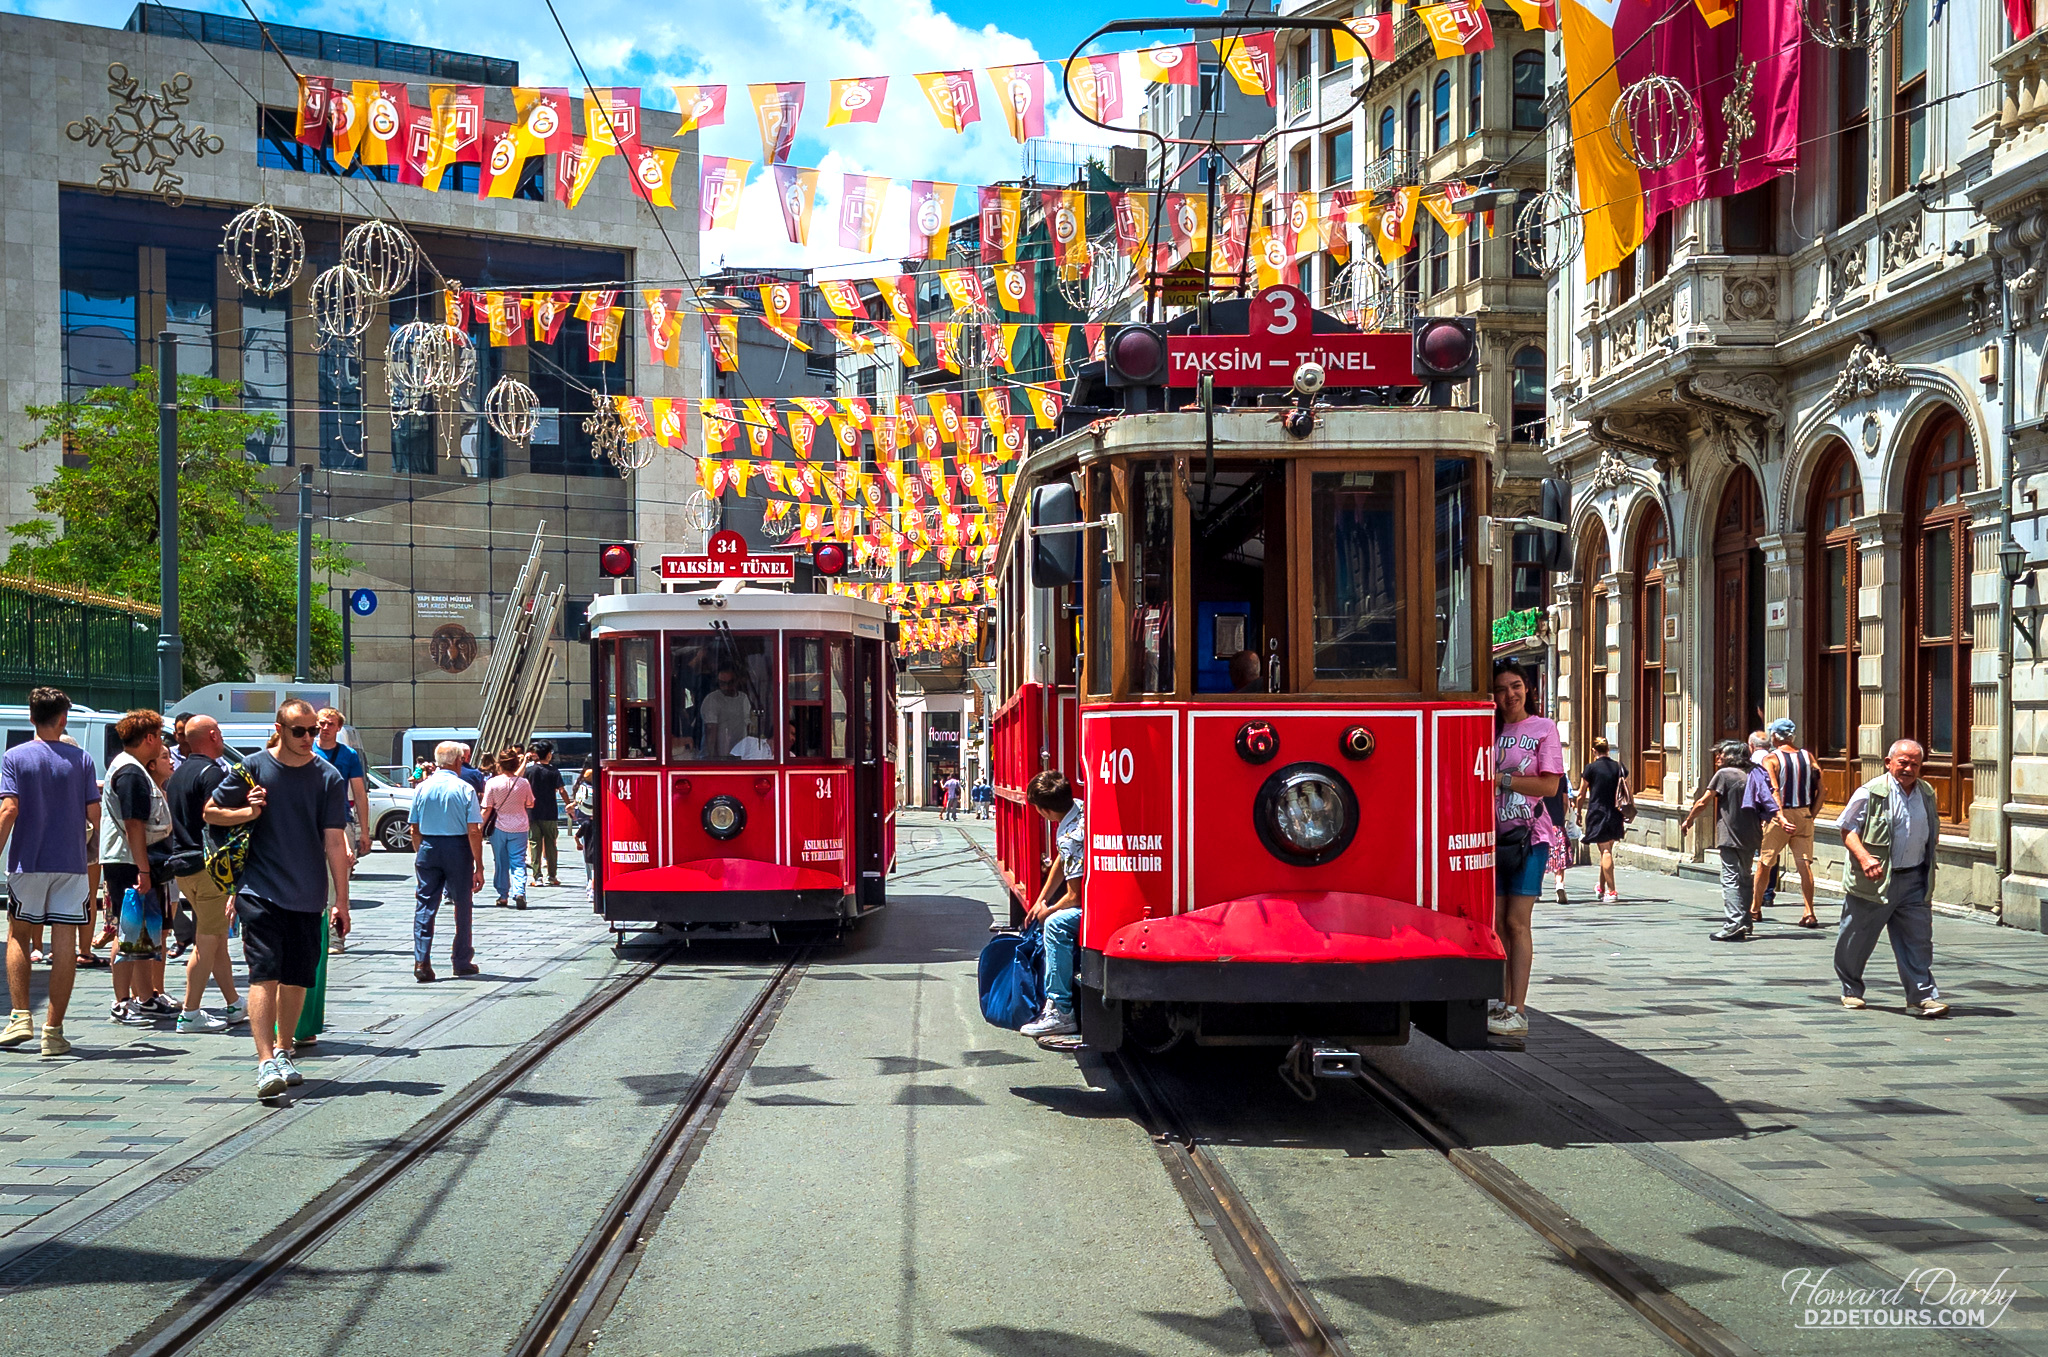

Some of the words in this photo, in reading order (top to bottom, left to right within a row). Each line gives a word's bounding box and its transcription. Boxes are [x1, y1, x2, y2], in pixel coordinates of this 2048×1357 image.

[1436, 9, 1475, 33] 24
[938, 86, 966, 107] 24
[444, 111, 471, 138] 24
[598, 112, 628, 134] 24
[1168, 294, 1198, 305] VOLT
[495, 306, 516, 326] 24
[1265, 290, 1297, 335] 3
[1171, 347, 1262, 371] TAKSİM
[1296, 347, 1376, 371] TÜNEL
[717, 539, 737, 554] 34
[667, 558, 725, 574] TAKSİM
[740, 558, 789, 574] TÜNEL
[1099, 747, 1134, 785] 410
[618, 778, 632, 800] 34
[816, 777, 832, 799] 34
[1126, 834, 1163, 851] YASAK
[1448, 832, 1487, 850] ASILMAK
[1449, 855, 1462, 872] VE
